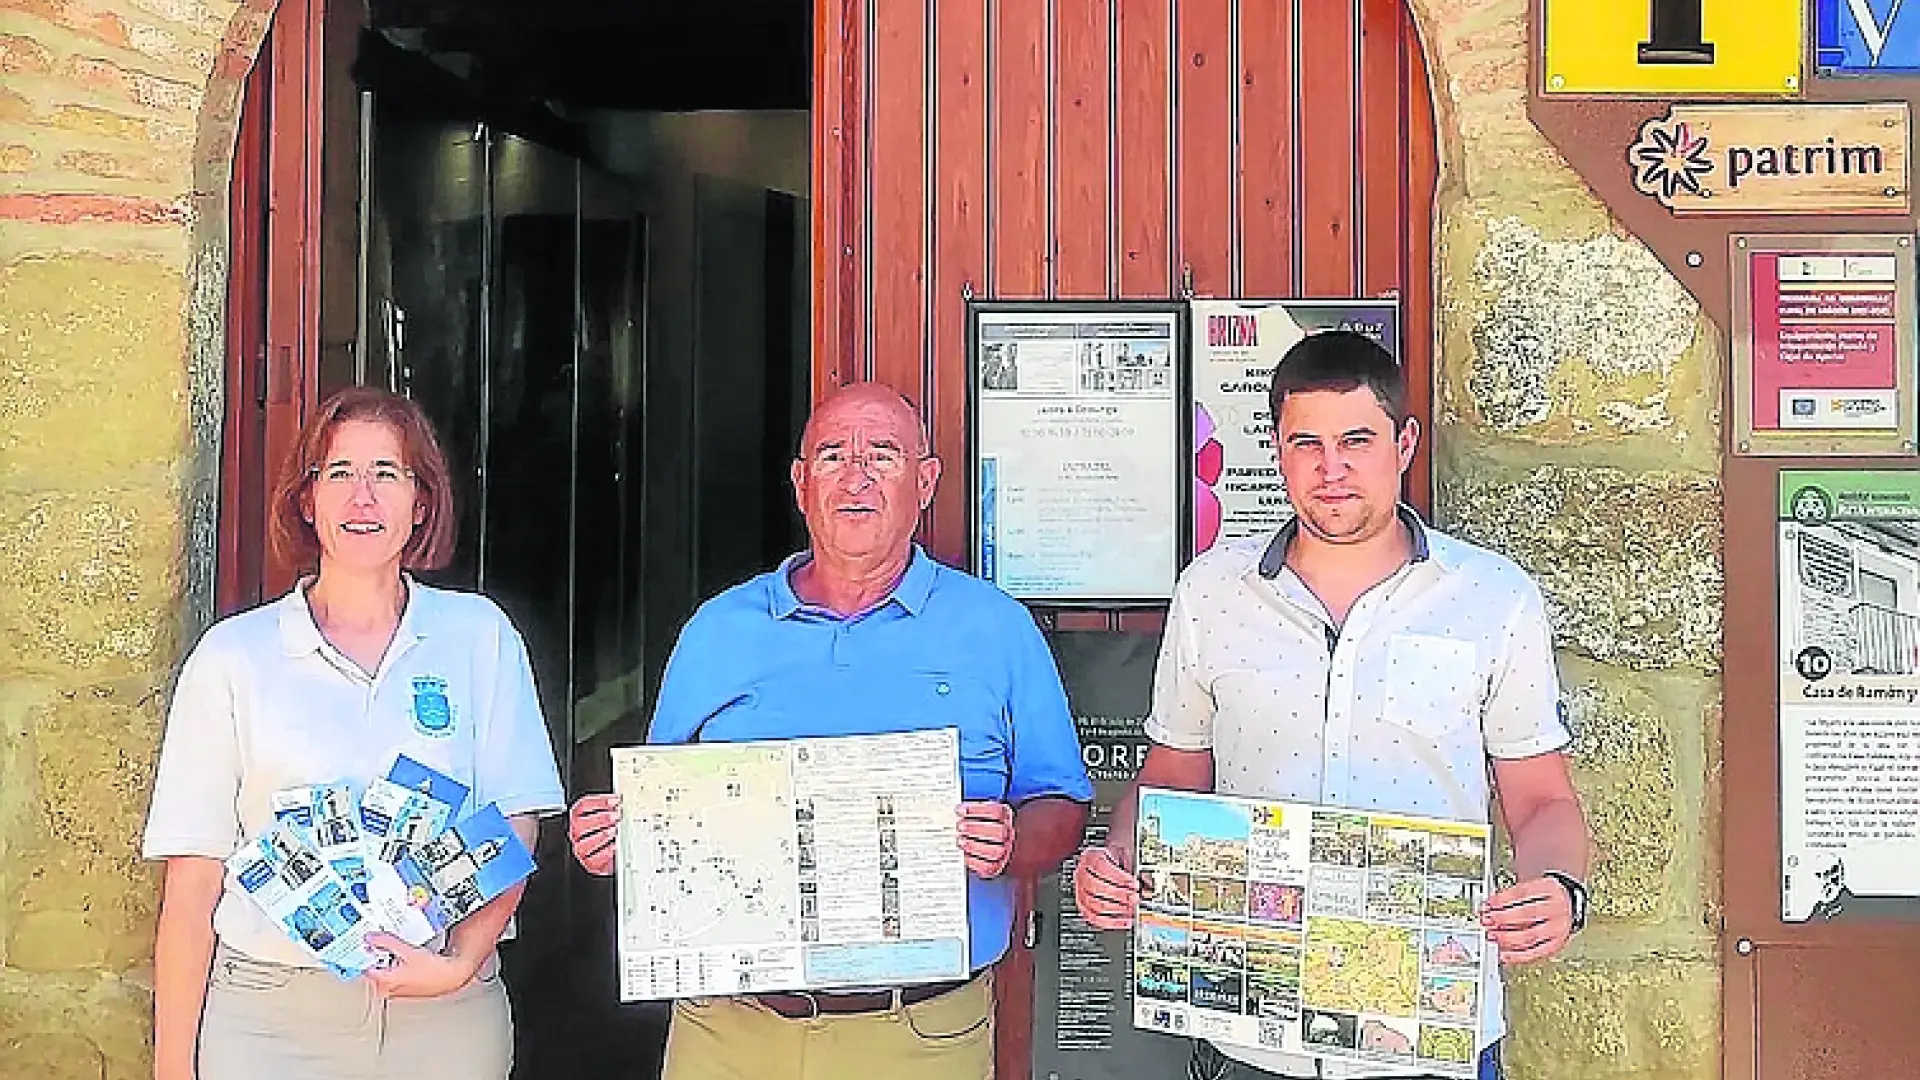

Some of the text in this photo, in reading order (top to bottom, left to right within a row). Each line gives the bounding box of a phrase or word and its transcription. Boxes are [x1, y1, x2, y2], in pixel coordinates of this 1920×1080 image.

[1728, 138, 1883, 187] patrim
[1208, 315, 1259, 346] BRIZNA
[1799, 655, 1829, 672] 10
[1802, 684, 1834, 698] Casa
[1838, 684, 1852, 698] de
[1856, 684, 1904, 698] Ramón
